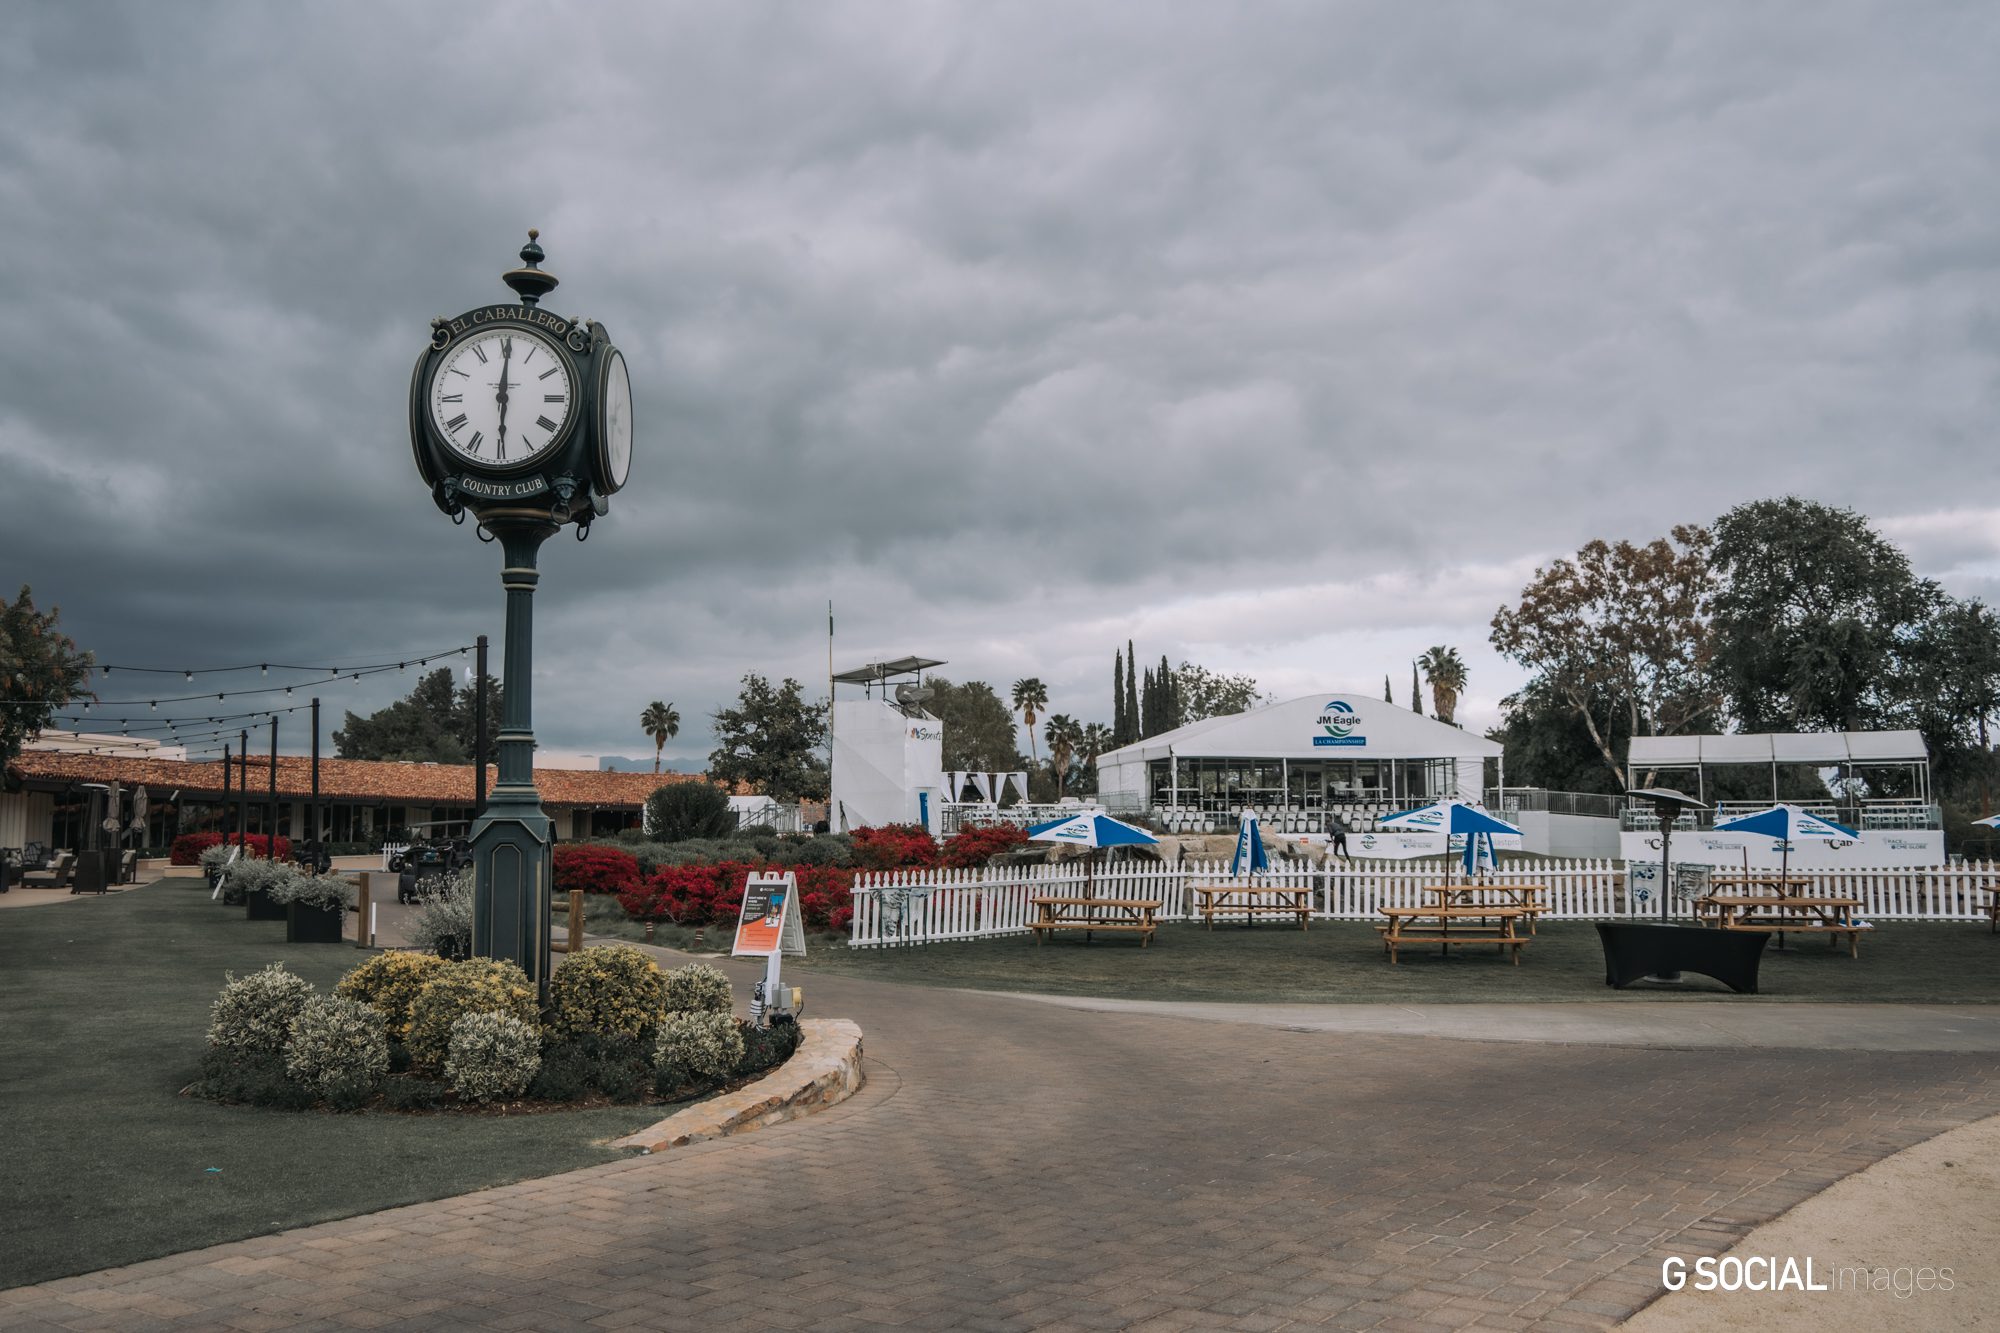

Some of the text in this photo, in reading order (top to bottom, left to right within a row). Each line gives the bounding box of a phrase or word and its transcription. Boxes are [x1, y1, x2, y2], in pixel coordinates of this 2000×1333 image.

[451, 307, 566, 334] EL CABALLERO
[463, 478, 543, 496] COUNTRY CLUB
[1317, 716, 1361, 726] JM Eagle
[920, 728, 943, 741] Sports
